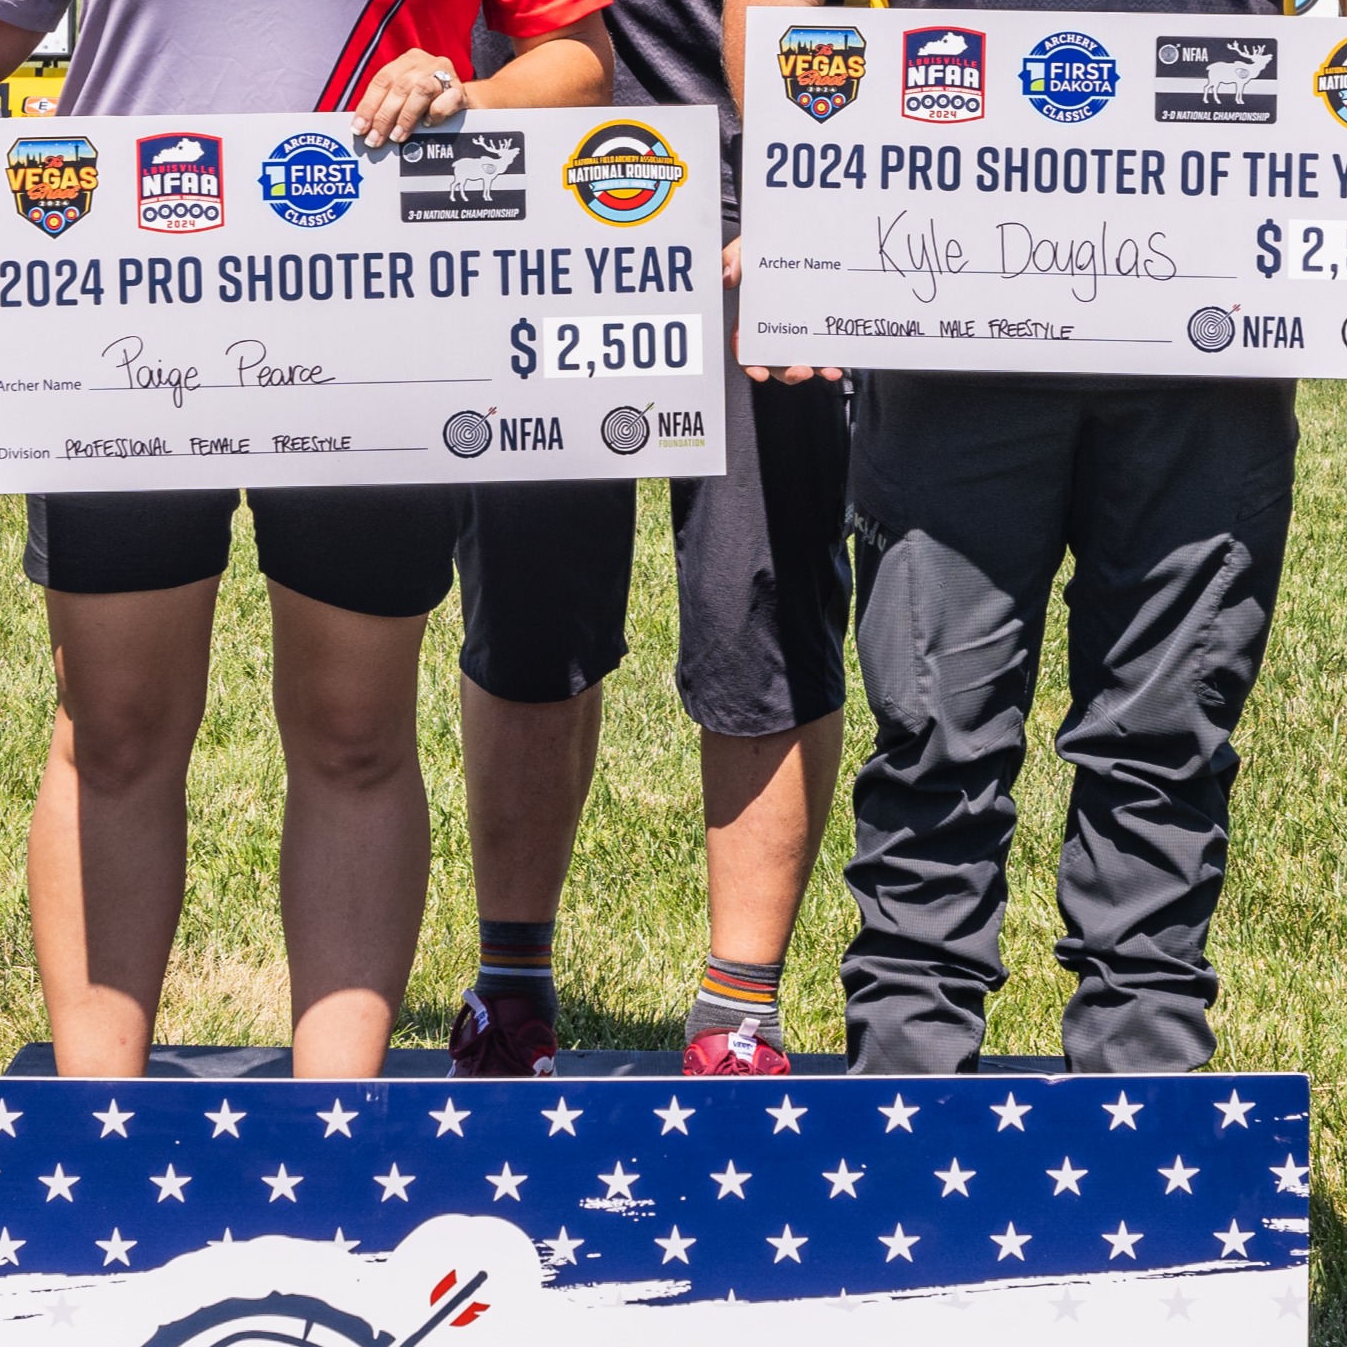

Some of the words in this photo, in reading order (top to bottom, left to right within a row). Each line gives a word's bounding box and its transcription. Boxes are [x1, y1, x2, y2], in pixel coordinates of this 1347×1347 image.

[1044, 34, 1097, 52] ARCHERY
[909, 56, 978, 68] LOUISVILLE
[1182, 48, 1208, 62] NFAA
[779, 55, 865, 78] VEGAS
[1051, 62, 1112, 81] FIRST
[908, 66, 979, 88] NFAA
[1051, 80, 1112, 93] DAKOTA
[1042, 105, 1092, 122] CLASSIC
[1176, 111, 1212, 120] NATIONAL
[1213, 111, 1270, 121] CHAMPIONSHIP
[284, 135, 339, 153] ARCHERY
[427, 144, 453, 159] NFAA
[143, 165, 215, 175] LOUISVILLE
[291, 165, 355, 183] FIRST
[568, 165, 624, 183] NATIONAL
[626, 164, 682, 181] ROUNDUP
[766, 143, 866, 189] 2024
[881, 145, 960, 191] PRO
[977, 147, 1165, 195] SHOOTER
[1181, 151, 1230, 196] OF
[1243, 152, 1318, 198] THE
[7, 167, 98, 193] VEGAS
[143, 173, 218, 196] NFAA
[291, 182, 356, 196] DAKOTA
[284, 208, 337, 227] CLASSIC
[408, 210, 422, 220] 3-D
[423, 209, 460, 220] NATIONAL
[461, 208, 519, 219] CHAMPIONSHIP
[877, 210, 970, 303] Kyle
[996, 221, 1178, 302] Douglas
[1257, 219, 1282, 278] $
[759, 257, 800, 270] Archer
[805, 257, 842, 271] Name
[0, 259, 104, 307] 2024
[119, 257, 202, 304] PRO
[219, 252, 414, 302] SHOOTER
[430, 251, 480, 297] OF
[493, 249, 572, 295] THE
[585, 246, 693, 293] YEAR
[758, 321, 808, 335] Division
[825, 317, 925, 338] PROFESSIONAL
[939, 320, 977, 338] MALE
[987, 321, 1074, 341] FREESTYLE
[1244, 316, 1304, 349] NFAA
[511, 318, 536, 380] $
[557, 321, 688, 379] 2,500
[102, 335, 201, 408] Paige
[226, 339, 335, 387] Pearce
[44, 378, 82, 391] Name
[501, 417, 563, 451] NFAA
[659, 412, 705, 437] NFAA
[65, 438, 172, 458] PROFESSIONAL
[189, 436, 250, 455] FEMALE
[272, 433, 351, 453] FREESTYLE
[659, 439, 705, 448] FOUNDATION
